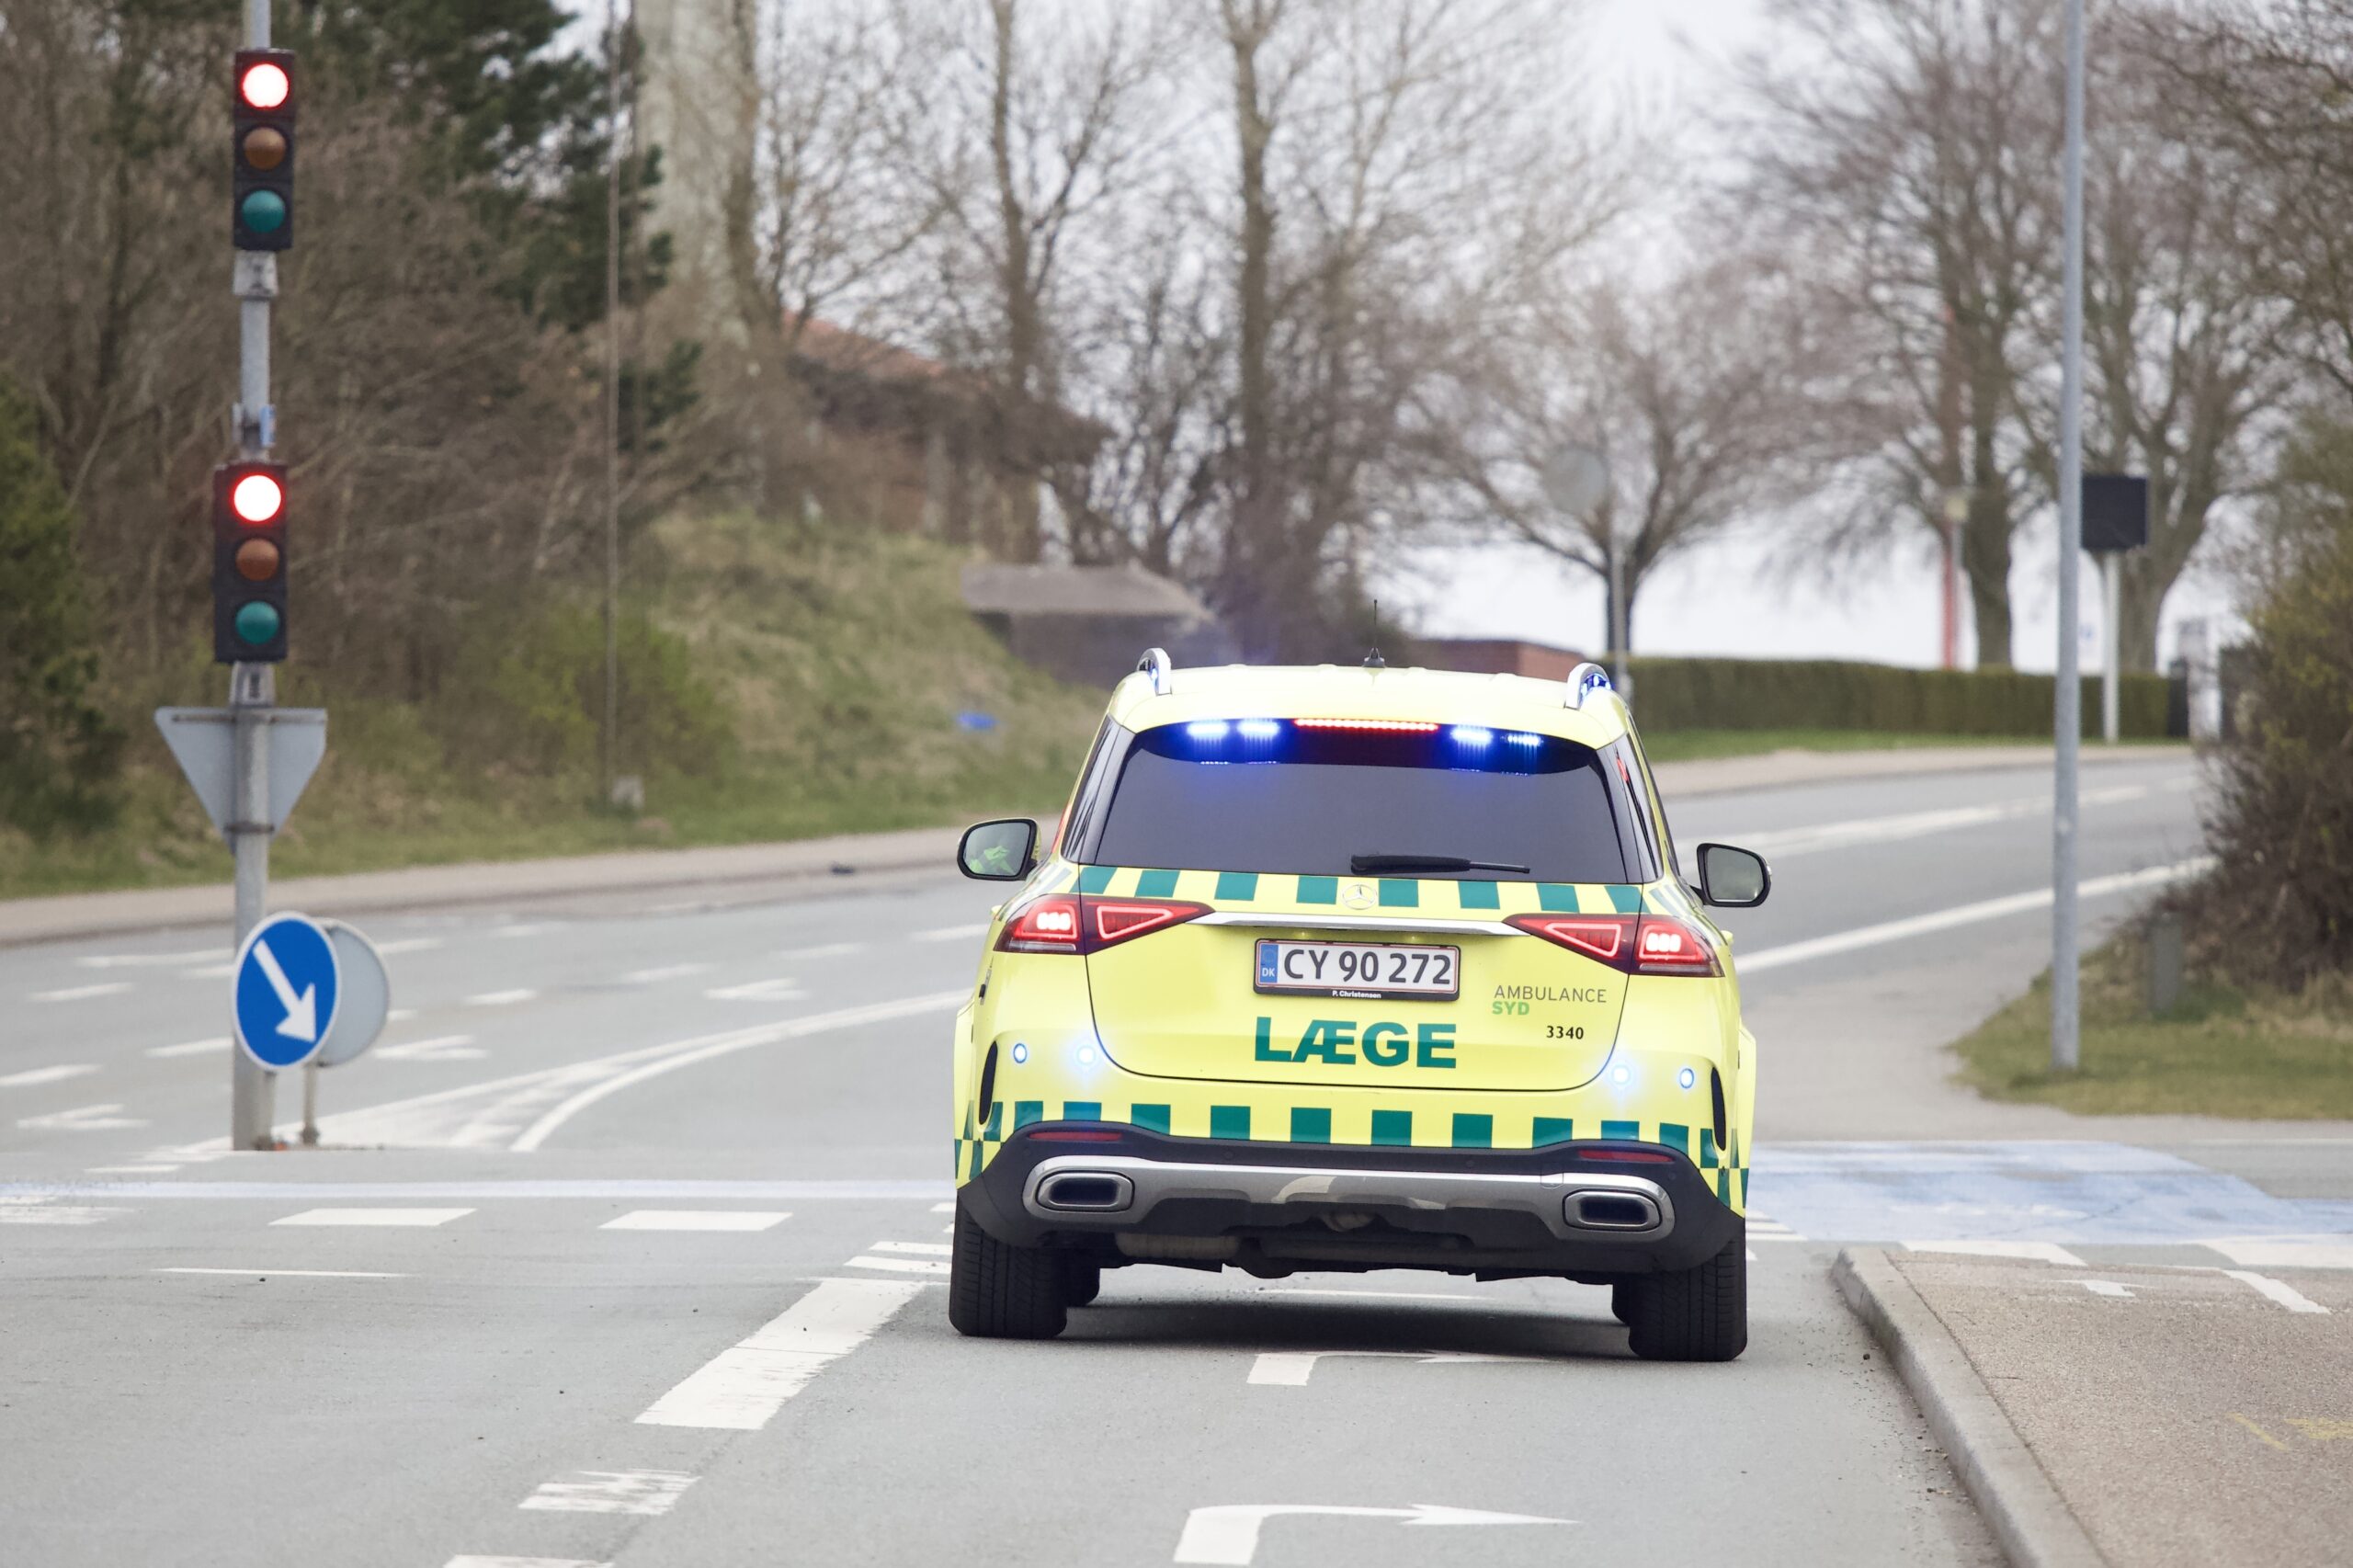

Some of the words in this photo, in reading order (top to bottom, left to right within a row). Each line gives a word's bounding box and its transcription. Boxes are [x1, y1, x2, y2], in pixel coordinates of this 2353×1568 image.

[1262, 968, 1275, 977] DK
[1283, 949, 1329, 980] CY
[1338, 950, 1380, 983] 90
[1388, 953, 1452, 985] 272
[1339, 990, 1381, 999] Christensen
[1494, 984, 1608, 1004] AMBULANCE
[1492, 1001, 1530, 1017] SYD
[1546, 1025, 1585, 1040] 3340
[1255, 1016, 1457, 1069] LÆGE
